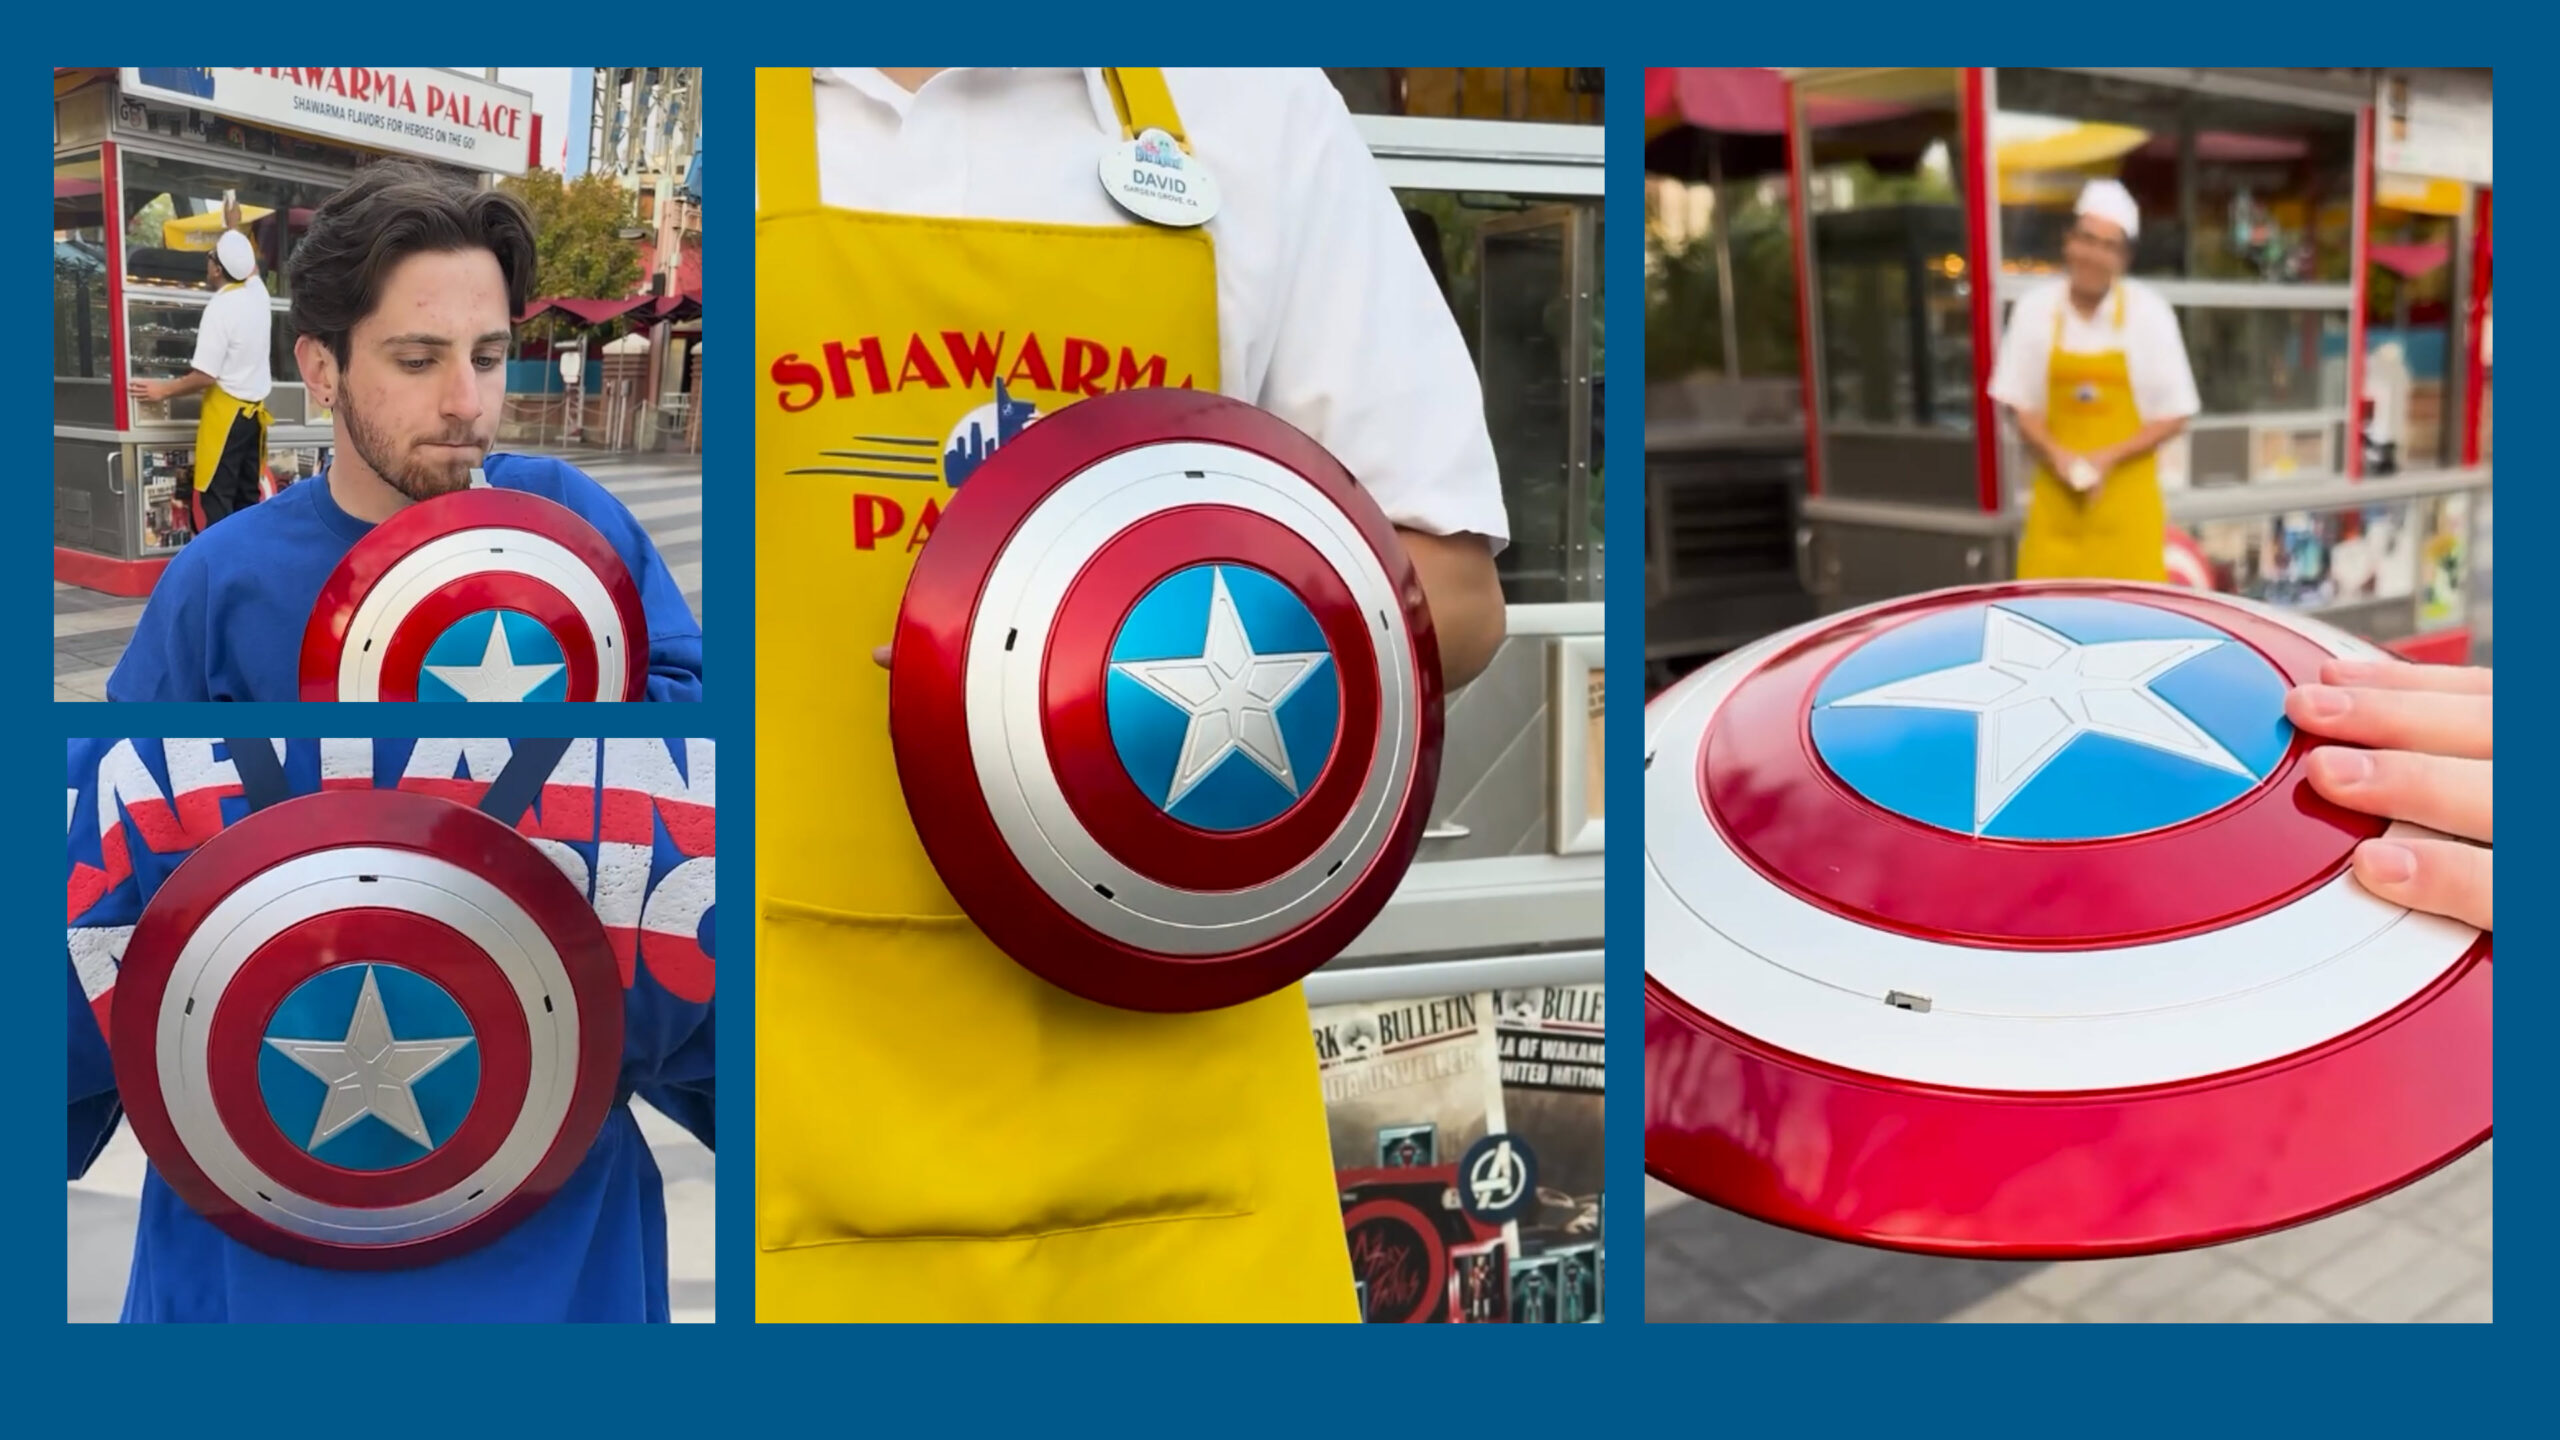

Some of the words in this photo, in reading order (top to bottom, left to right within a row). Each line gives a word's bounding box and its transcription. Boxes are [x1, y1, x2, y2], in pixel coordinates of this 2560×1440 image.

[293, 96, 346, 121] SHAWARMA
[348, 109, 385, 131] FLAVORS
[386, 118, 403, 133] FOR
[404, 123, 434, 141] HEROES
[435, 130, 447, 143] ON
[448, 132, 462, 147] THE
[462, 136, 476, 151] GO!
[427, 84, 521, 141] PALACE
[1122, 184, 1157, 198] GARDEN
[1186, 198, 1199, 208] CA
[1132, 169, 1187, 195] DAVID
[771, 331, 1195, 413] SHAWARM
[1378, 991, 1477, 1046] BULLETIN
[1518, 1037, 1541, 1059] OF
